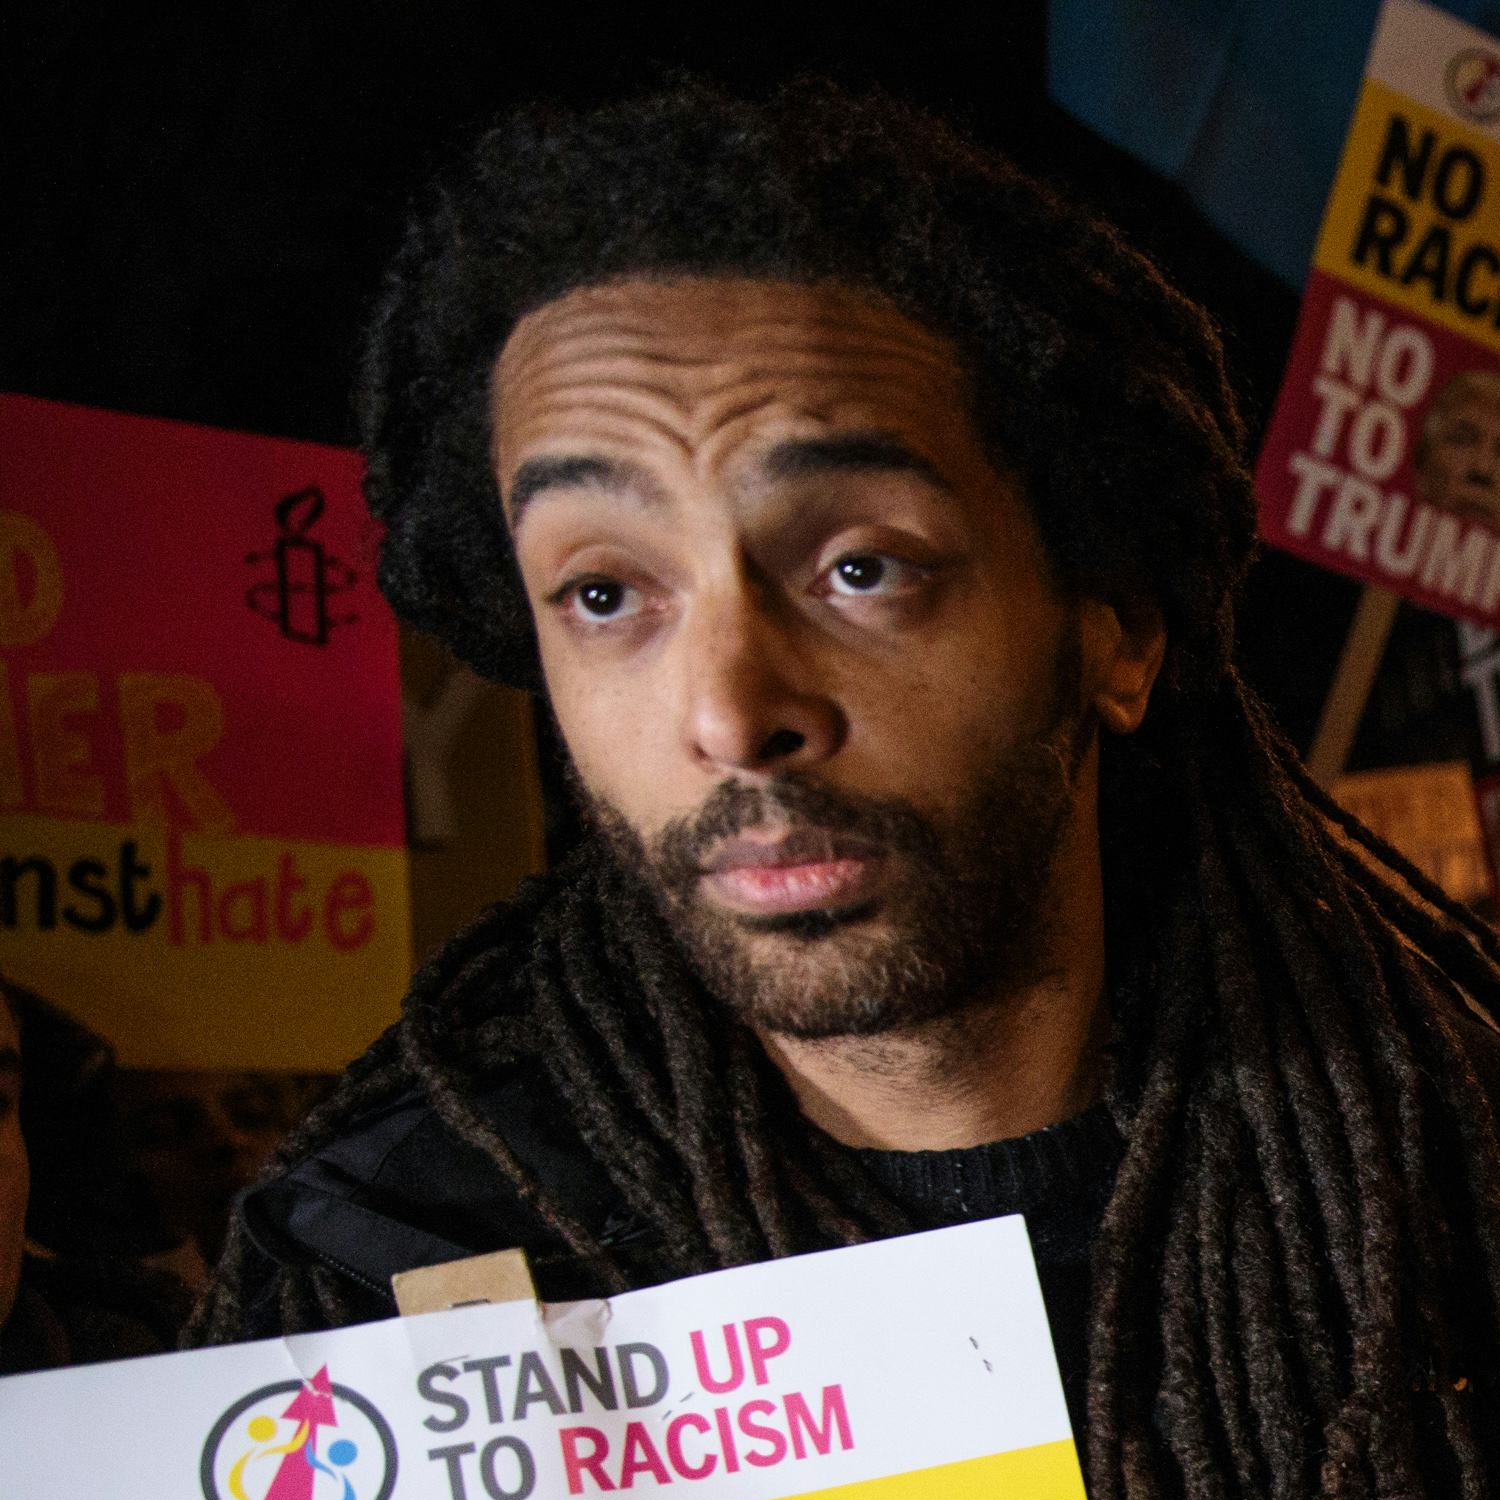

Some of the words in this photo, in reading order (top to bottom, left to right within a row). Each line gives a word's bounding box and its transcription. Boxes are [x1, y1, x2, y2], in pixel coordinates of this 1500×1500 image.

[1375, 114, 1484, 221] NO
[1318, 298, 1436, 408] NO
[1309, 376, 1411, 482] TO
[165, 818, 377, 952] hate
[416, 1340, 670, 1434] STAND
[689, 1315, 793, 1396] UP
[560, 1383, 857, 1496] RACISM
